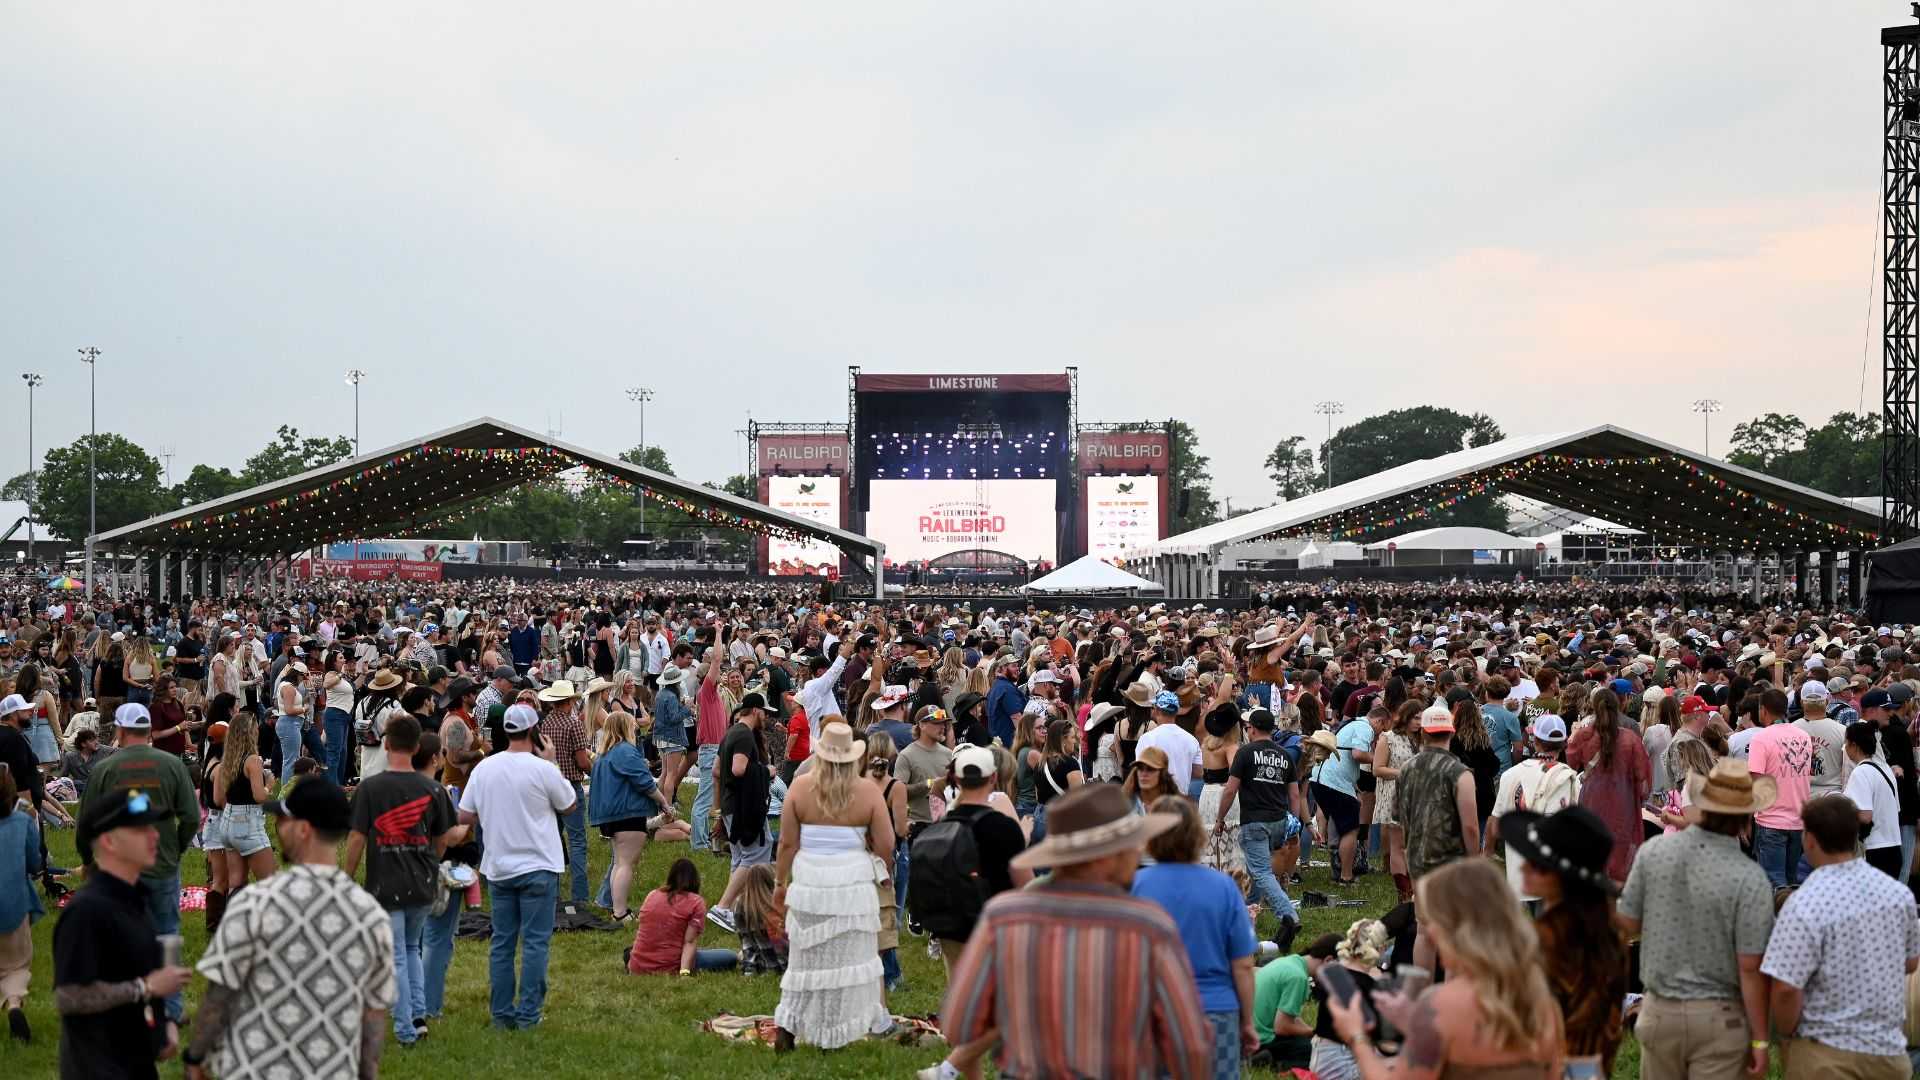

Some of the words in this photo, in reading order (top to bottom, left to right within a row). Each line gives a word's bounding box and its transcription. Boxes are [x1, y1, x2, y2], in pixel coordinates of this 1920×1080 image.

[929, 377, 998, 389] LIMESTONE
[767, 446, 842, 459] RAILBIRD
[1087, 444, 1162, 457] RAILBIRD
[919, 515, 1005, 533] RAILBIRD
[312, 563, 353, 577] EXIT
[401, 564, 439, 572] EMERGENCY
[1253, 750, 1289, 770] Modelo
